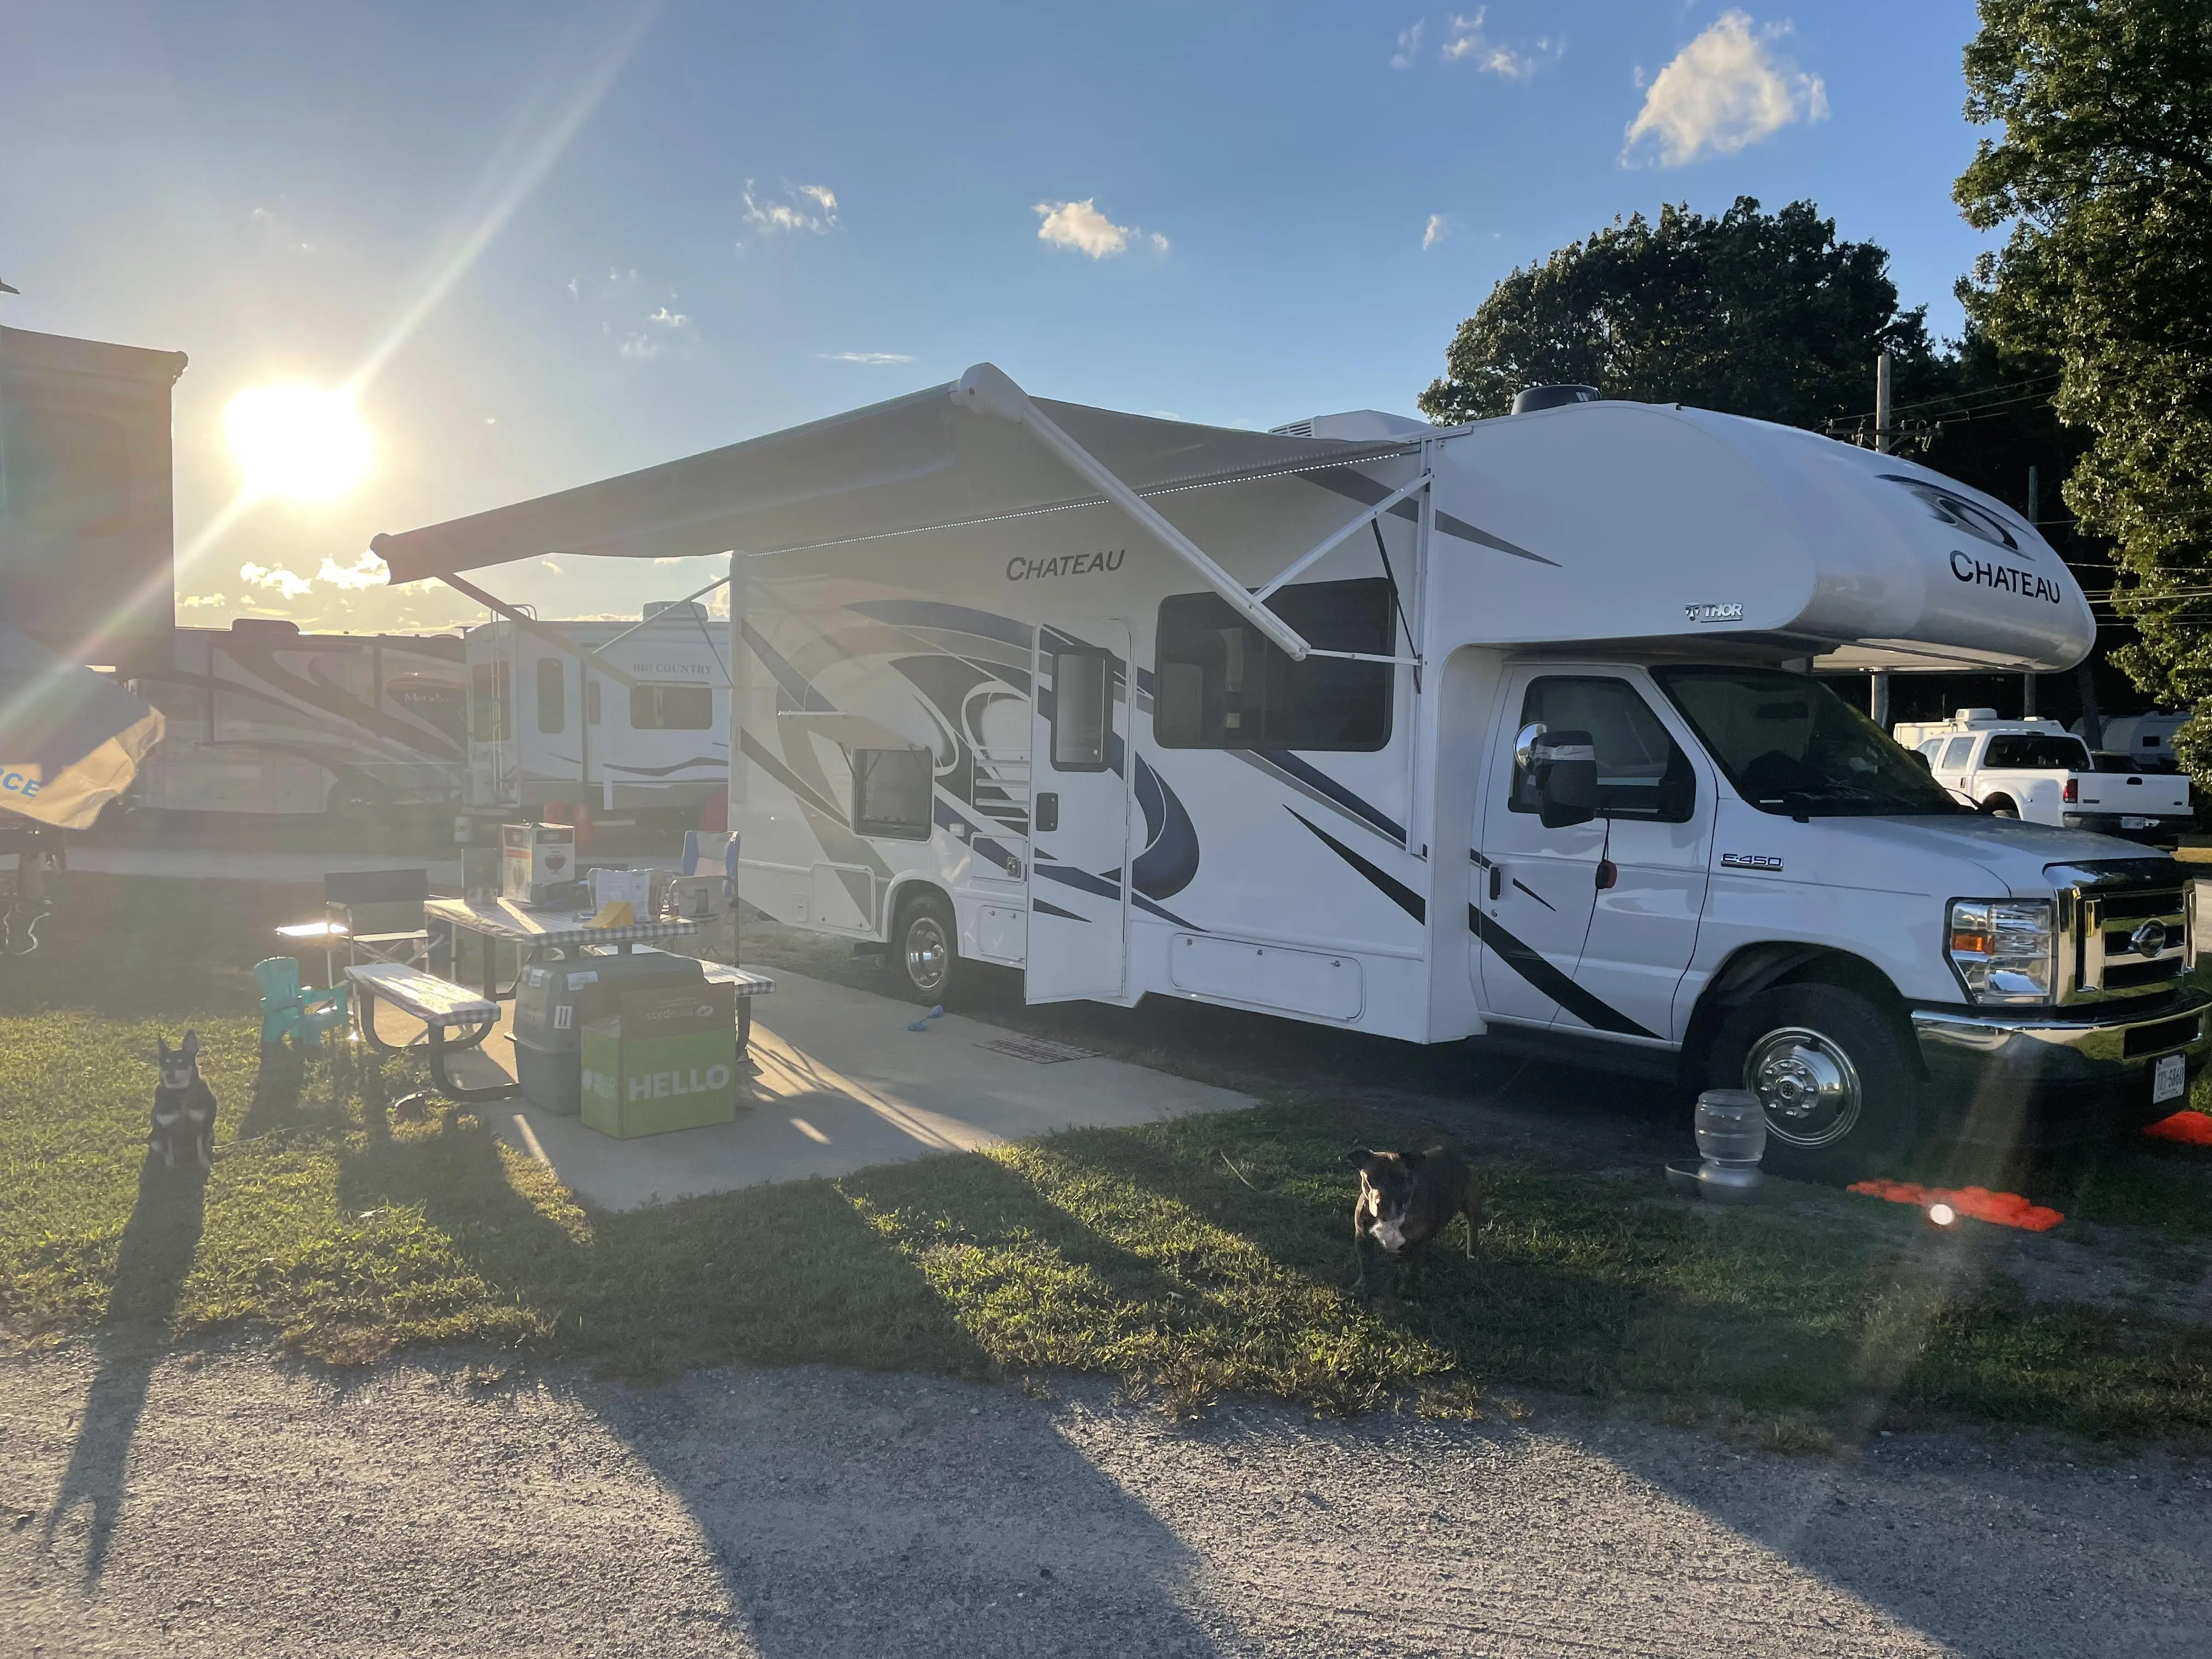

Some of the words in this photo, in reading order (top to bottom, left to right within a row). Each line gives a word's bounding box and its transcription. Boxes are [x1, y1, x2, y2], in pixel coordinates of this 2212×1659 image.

[1006, 549, 1125, 581] CHATEAU
[1950, 550, 2060, 604] CHATEAU
[1702, 603, 1742, 617] THOR
[633, 663, 653, 673] BIG
[656, 663, 712, 674] COUNTRY
[0, 765, 40, 798] CE
[629, 1063, 730, 1102] HELLO
